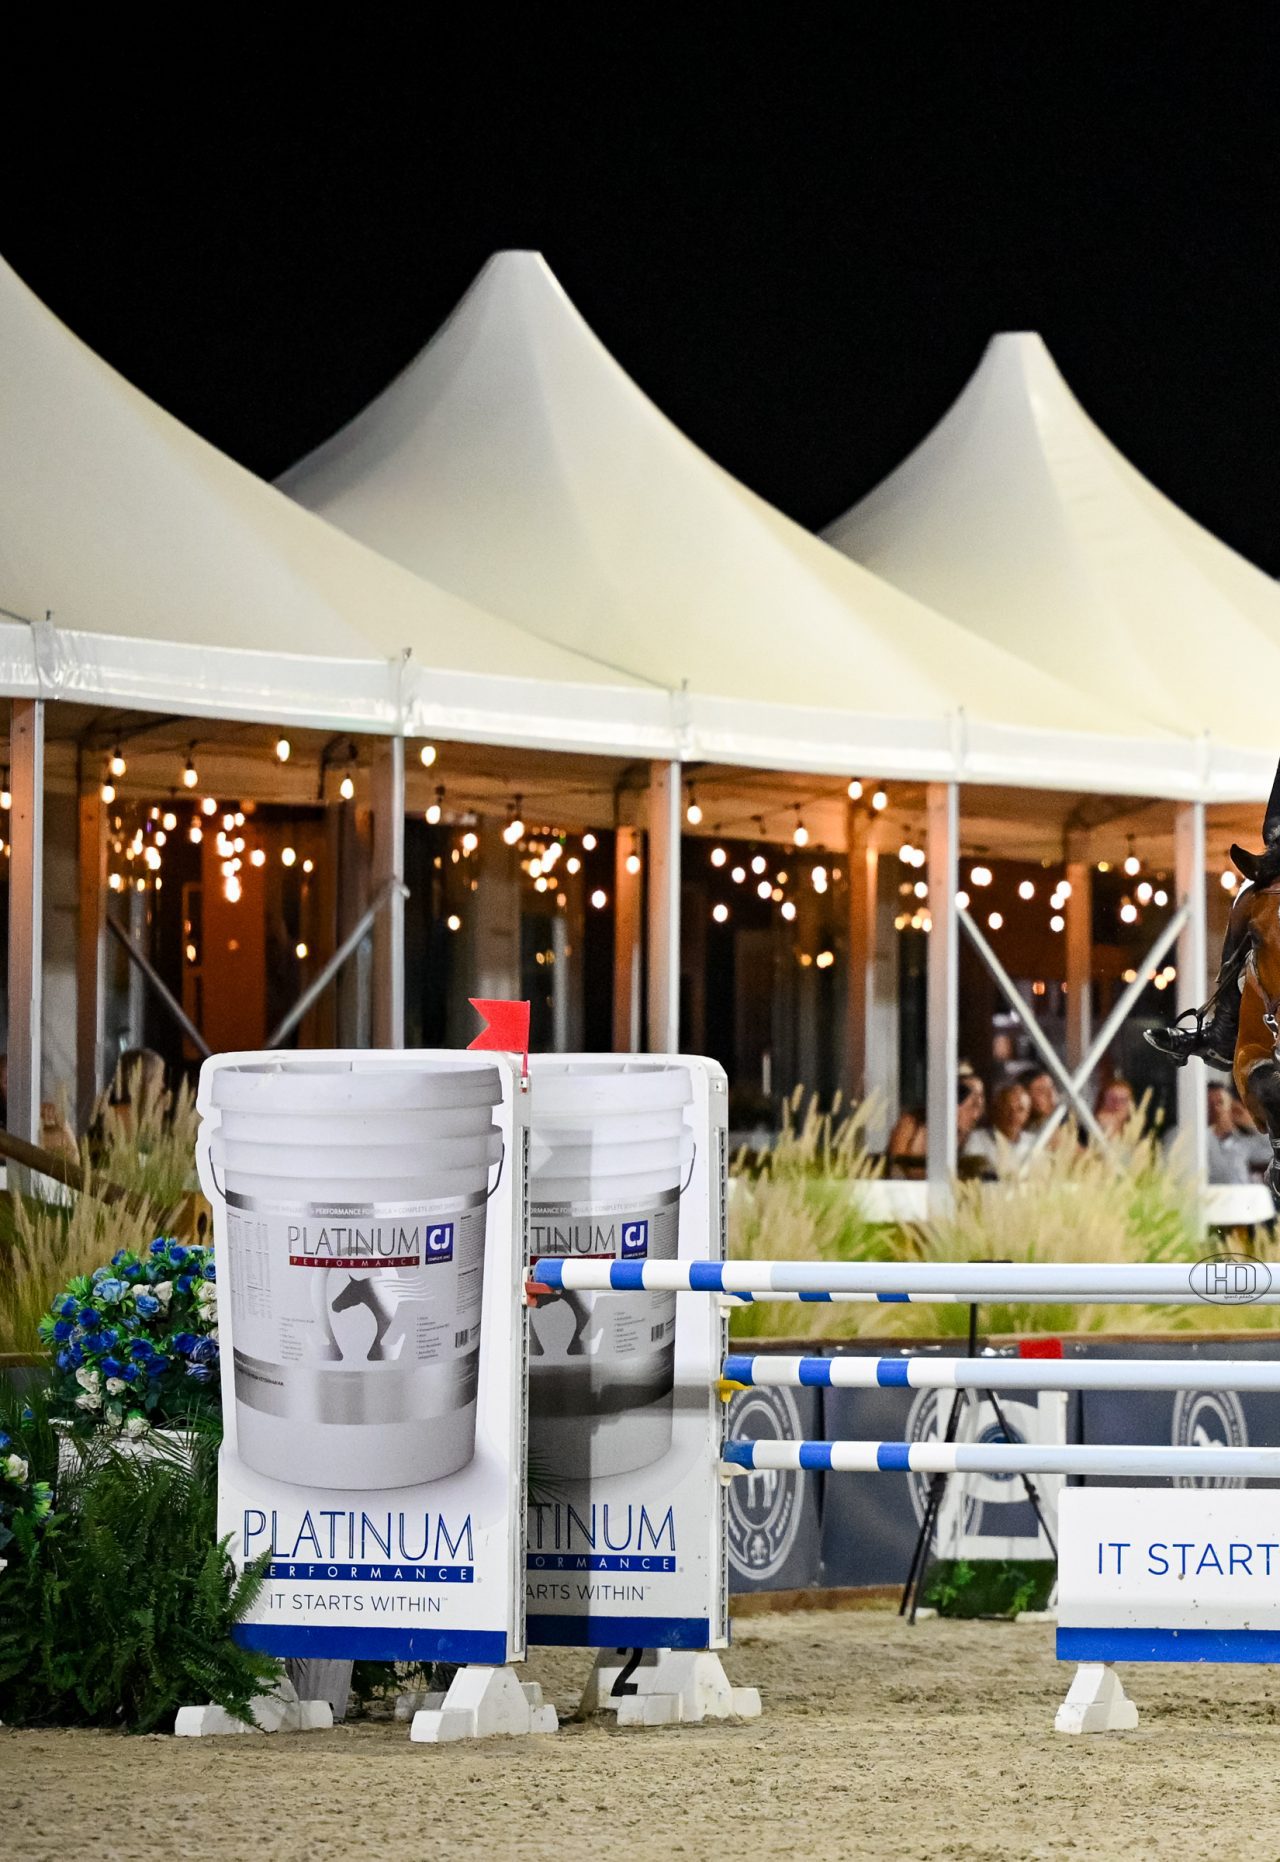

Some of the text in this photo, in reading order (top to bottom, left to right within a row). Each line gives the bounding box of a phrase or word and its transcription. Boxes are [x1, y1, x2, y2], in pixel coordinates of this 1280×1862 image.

[288, 1225, 419, 1256] PLATINUM
[429, 1227, 450, 1251] CJ
[531, 1224, 616, 1254] TINUM
[624, 1225, 645, 1247] CJ
[293, 1257, 417, 1267] PERFORMANCE
[243, 1509, 474, 1562] PLATINUM
[528, 1503, 676, 1552] TINUM
[535, 1556, 670, 1570] ORMANCE
[1098, 1542, 1131, 1575] IT
[262, 1563, 467, 1580] ERFORMANCE
[270, 1594, 286, 1610] IT
[292, 1594, 364, 1611] STARTS
[526, 1584, 570, 1600] ARTS
[610, 1648, 643, 1697] 2
